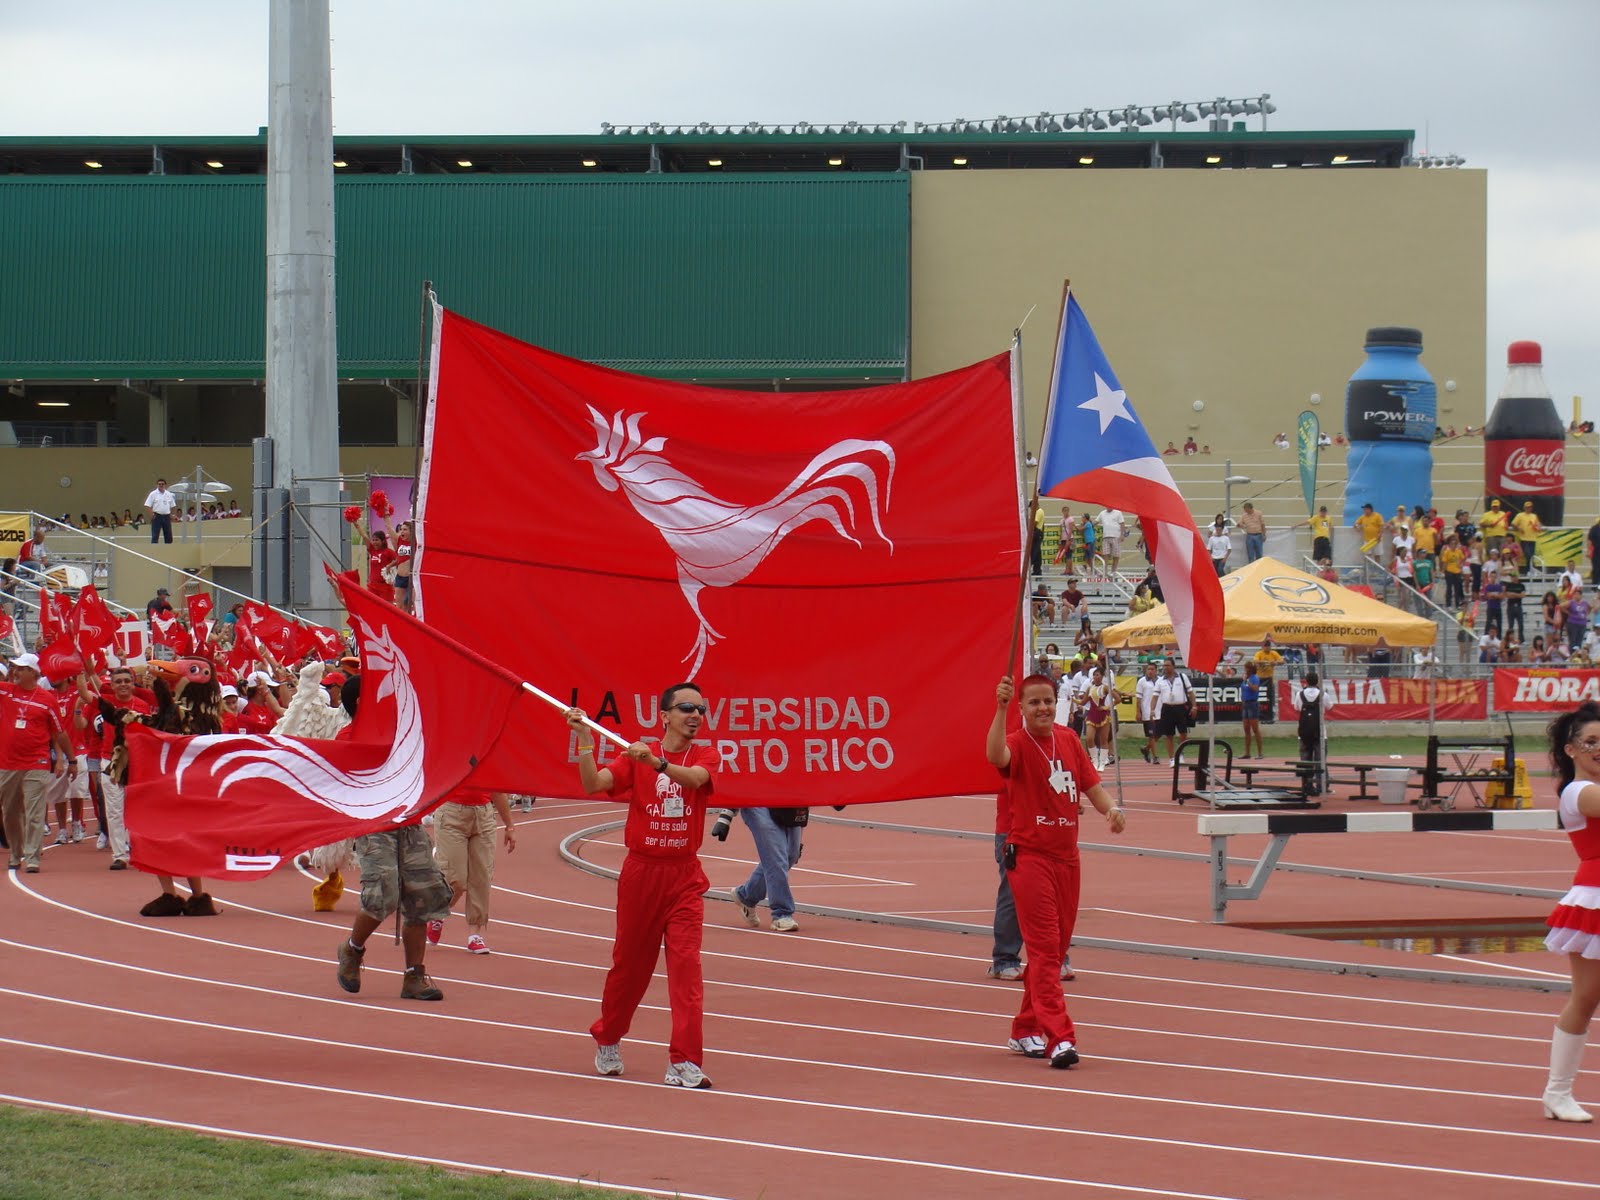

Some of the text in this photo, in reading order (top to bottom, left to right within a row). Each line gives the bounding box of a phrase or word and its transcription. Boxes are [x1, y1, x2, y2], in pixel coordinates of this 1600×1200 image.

[1274, 625, 1377, 637] www.mazdapr.com
[1513, 677, 1600, 702] HORA
[634, 693, 890, 732] UVERSIDAD
[804, 737, 894, 773] RICO
[645, 803, 692, 818] GALO
[650, 819, 687, 831] no es solo
[645, 835, 688, 850] ser el mejor
